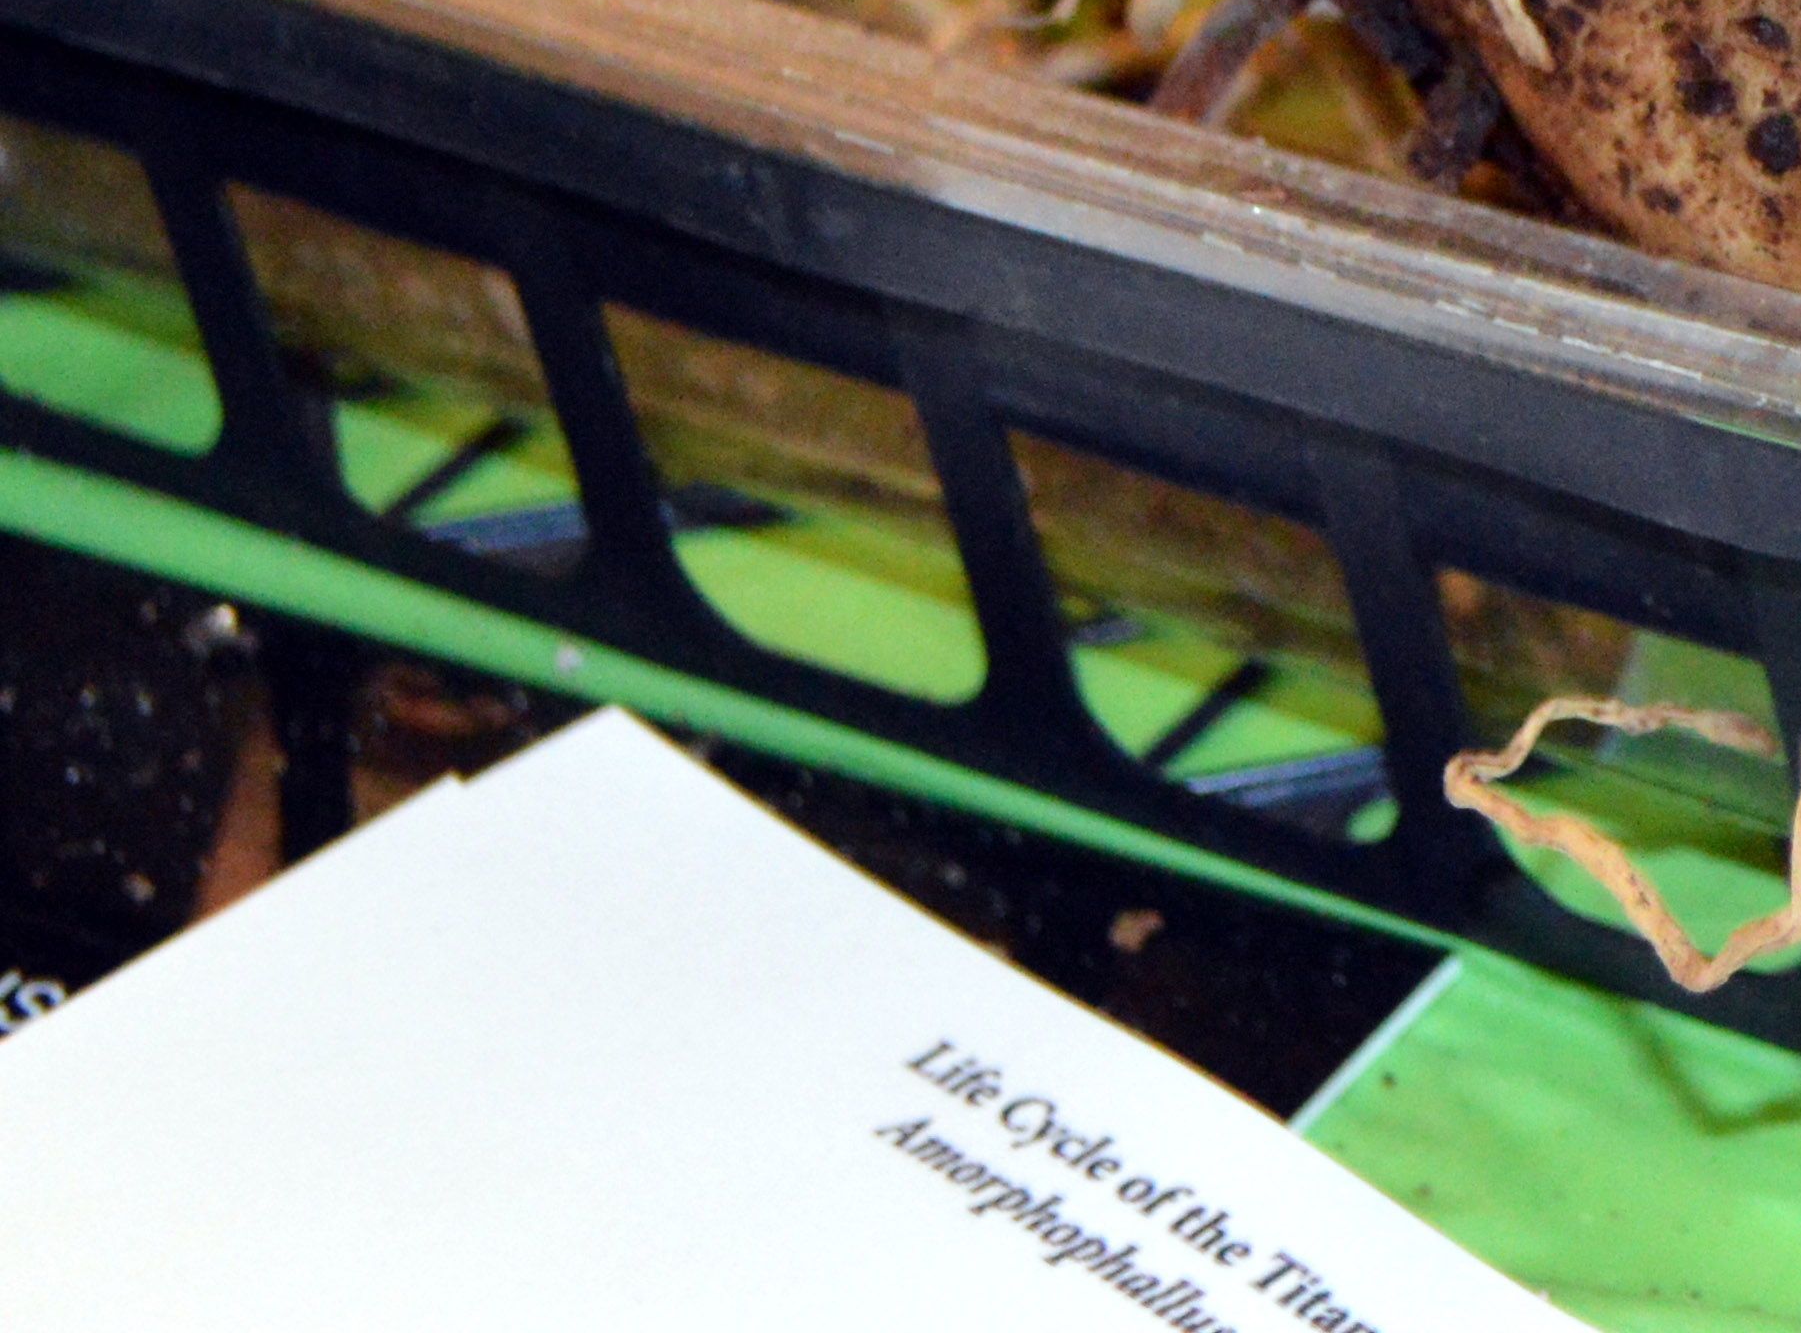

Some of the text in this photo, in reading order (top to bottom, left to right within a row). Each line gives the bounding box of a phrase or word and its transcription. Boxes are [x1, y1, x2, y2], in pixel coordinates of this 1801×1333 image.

[874, 1117, 1238, 1333] Amorphophallu
[905, 1039, 1001, 1107] Life
[1000, 1095, 1121, 1181] Cycle
[1117, 1173, 1194, 1218] of
[1168, 1206, 1252, 1267] the
